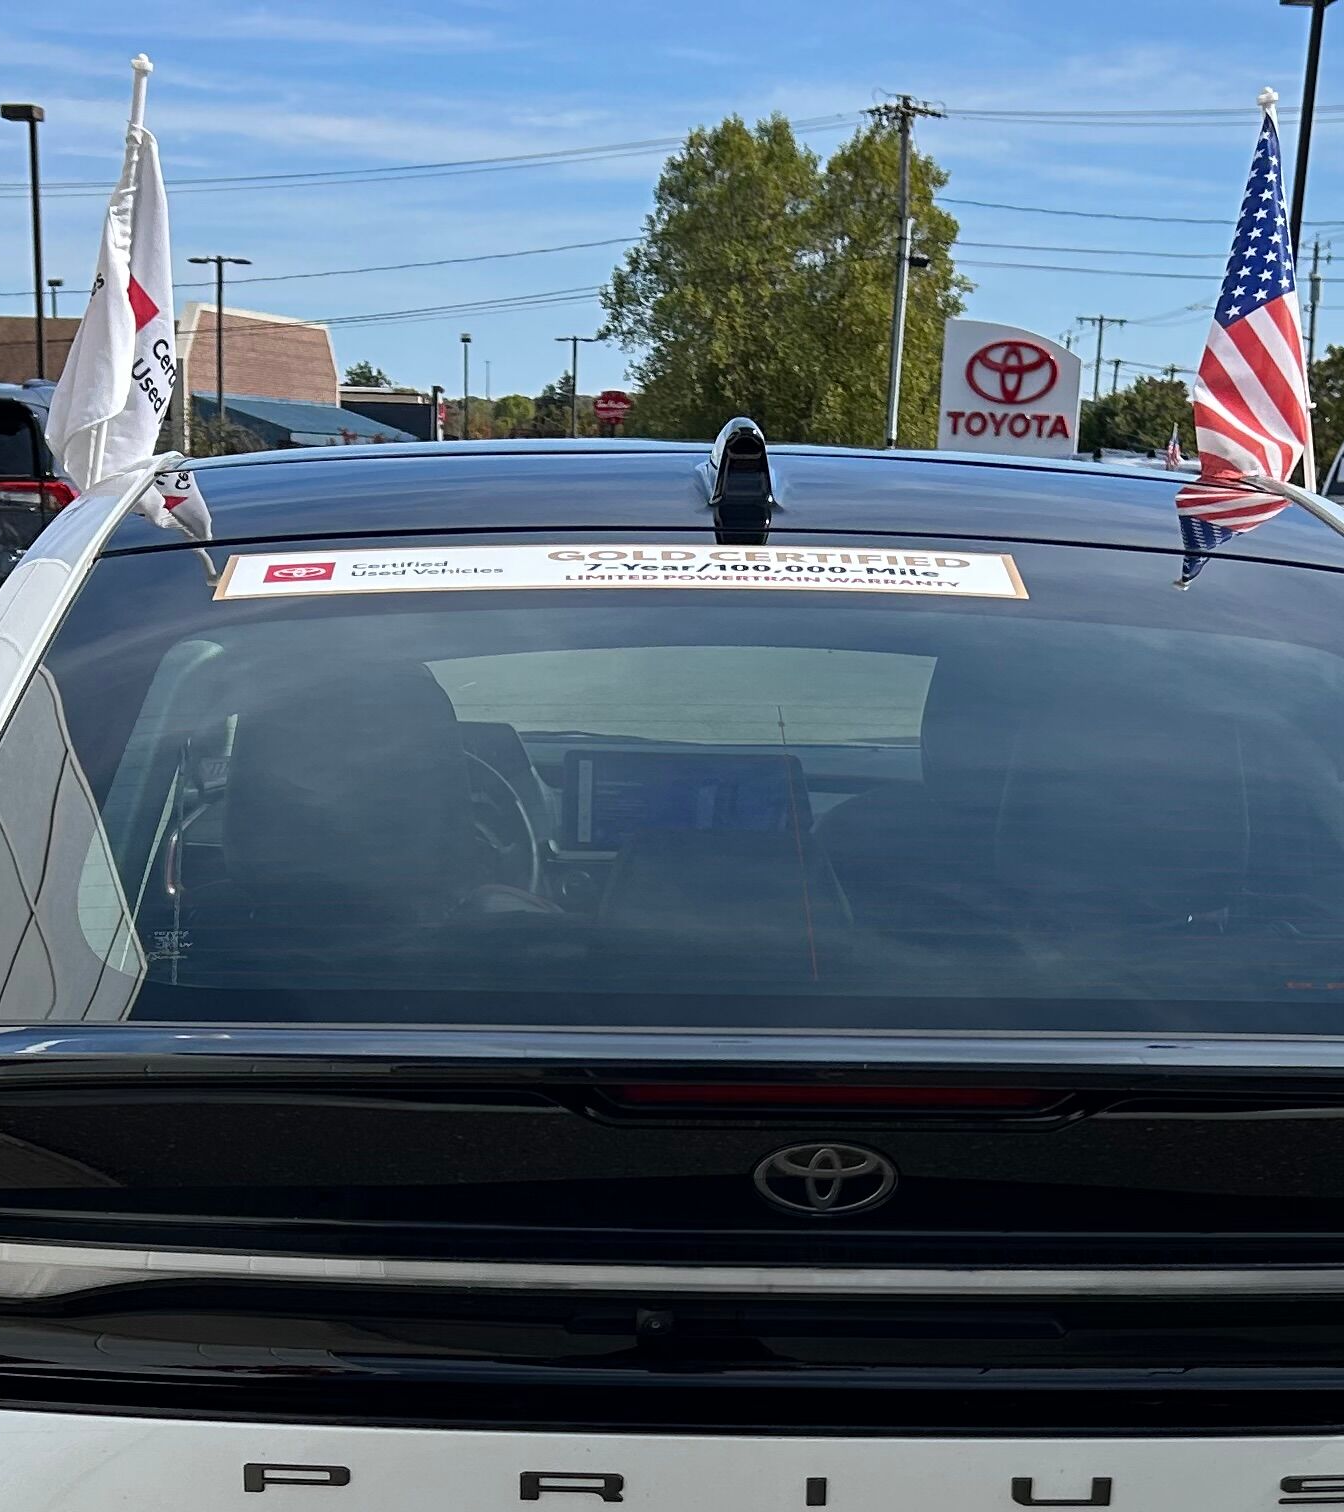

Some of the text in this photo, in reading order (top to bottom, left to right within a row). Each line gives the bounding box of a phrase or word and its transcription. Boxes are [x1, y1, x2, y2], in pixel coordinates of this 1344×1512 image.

[131, 357, 167, 415] Used
[946, 410, 1069, 439] TOYOTA
[352, 560, 448, 570] Certified
[547, 550, 971, 568] GOLD CERTIFIED
[351, 567, 504, 577] Used Vehicles
[663, 574, 821, 583] POWERTRAIN
[825, 577, 960, 588] WARRANTY
